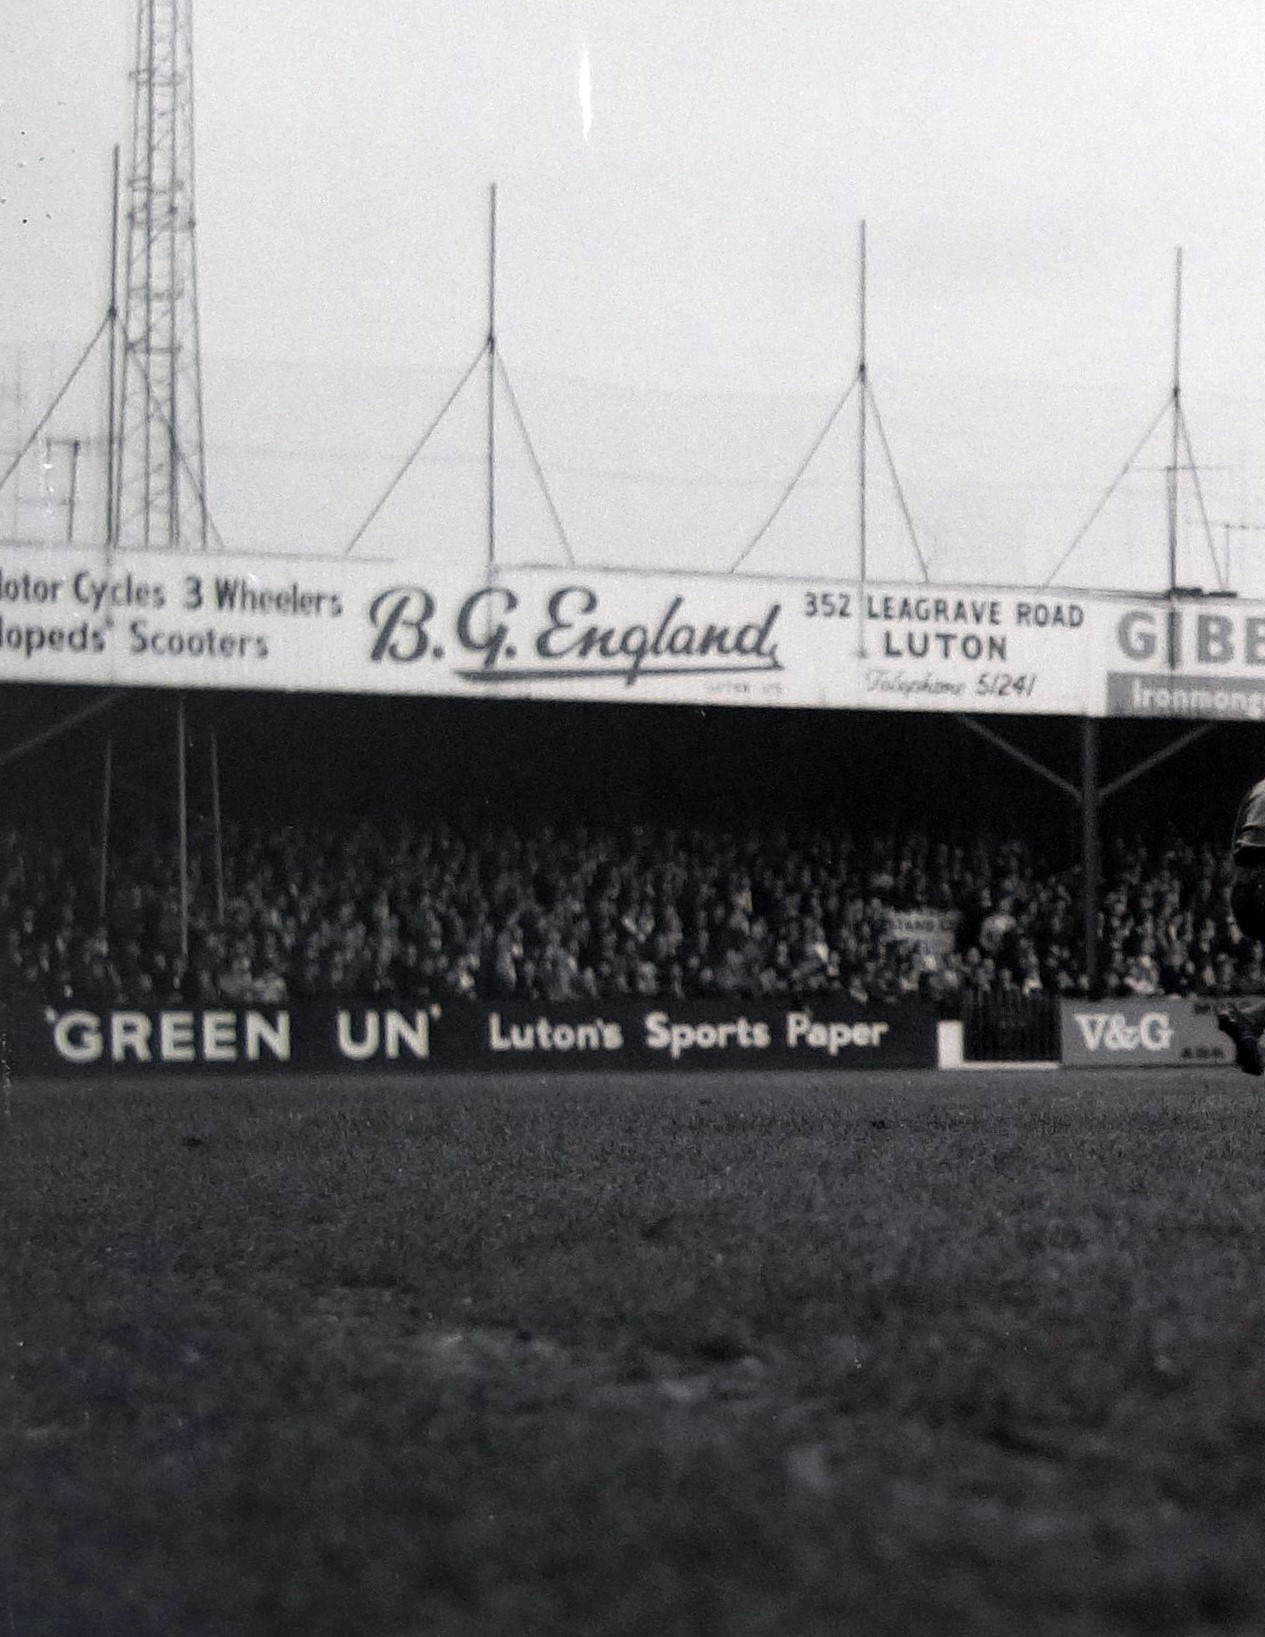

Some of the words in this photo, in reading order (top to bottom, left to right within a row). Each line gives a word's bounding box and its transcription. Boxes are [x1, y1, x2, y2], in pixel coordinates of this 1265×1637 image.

[0, 568, 63, 603] otor
[73, 570, 166, 611] Cycles
[185, 575, 203, 610] 3
[215, 575, 343, 617] Wheelers
[804, 591, 852, 617] 352
[867, 595, 1002, 625] LEAGRAVE
[1016, 602, 1085, 627] ROAD
[0, 614, 106, 659] opeds
[130, 619, 269, 659] Scooters
[536, 586, 783, 685] England
[884, 630, 1008, 661] LUTON
[489, 1011, 624, 1050] Luton's
[645, 1009, 771, 1059] Sports
[786, 1010, 889, 1056] Paper
[1074, 1010, 1174, 1052] V&G
